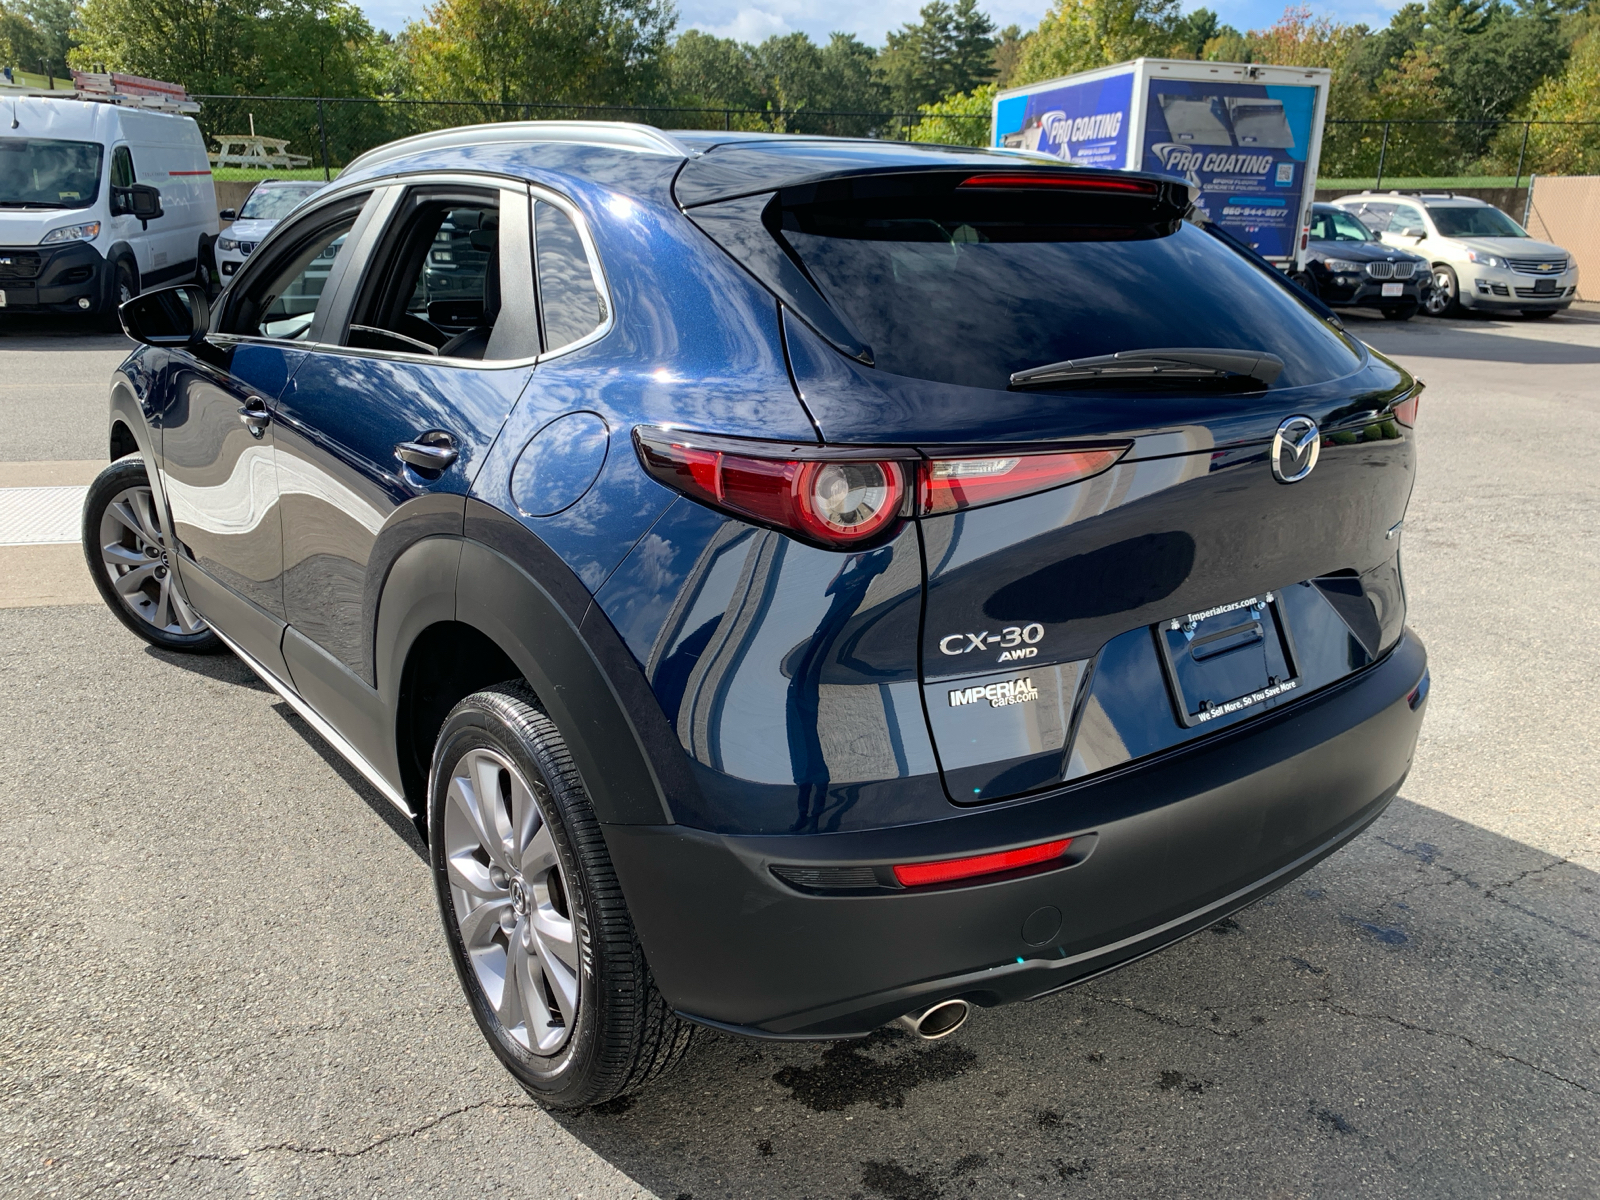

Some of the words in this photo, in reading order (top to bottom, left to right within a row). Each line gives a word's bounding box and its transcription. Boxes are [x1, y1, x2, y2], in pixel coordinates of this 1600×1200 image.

[1048, 119, 1073, 145] PRO
[1071, 111, 1122, 142] COATING
[1166, 152, 1202, 171] PRO
[1202, 153, 1273, 174] COATING
[1187, 597, 1257, 621] Imperialcars.com
[939, 623, 1045, 656] CX-30
[997, 646, 1038, 663] AWD
[949, 677, 1038, 707] IMPERIAL
[990, 691, 1038, 708] cars.com
[1198, 712, 1211, 722] We
[1210, 705, 1224, 718] Sell
[1224, 700, 1243, 713] More,
[1242, 697, 1252, 706] So
[1251, 692, 1265, 703] You
[1264, 686, 1280, 698] Save
[1280, 681, 1297, 693] More
